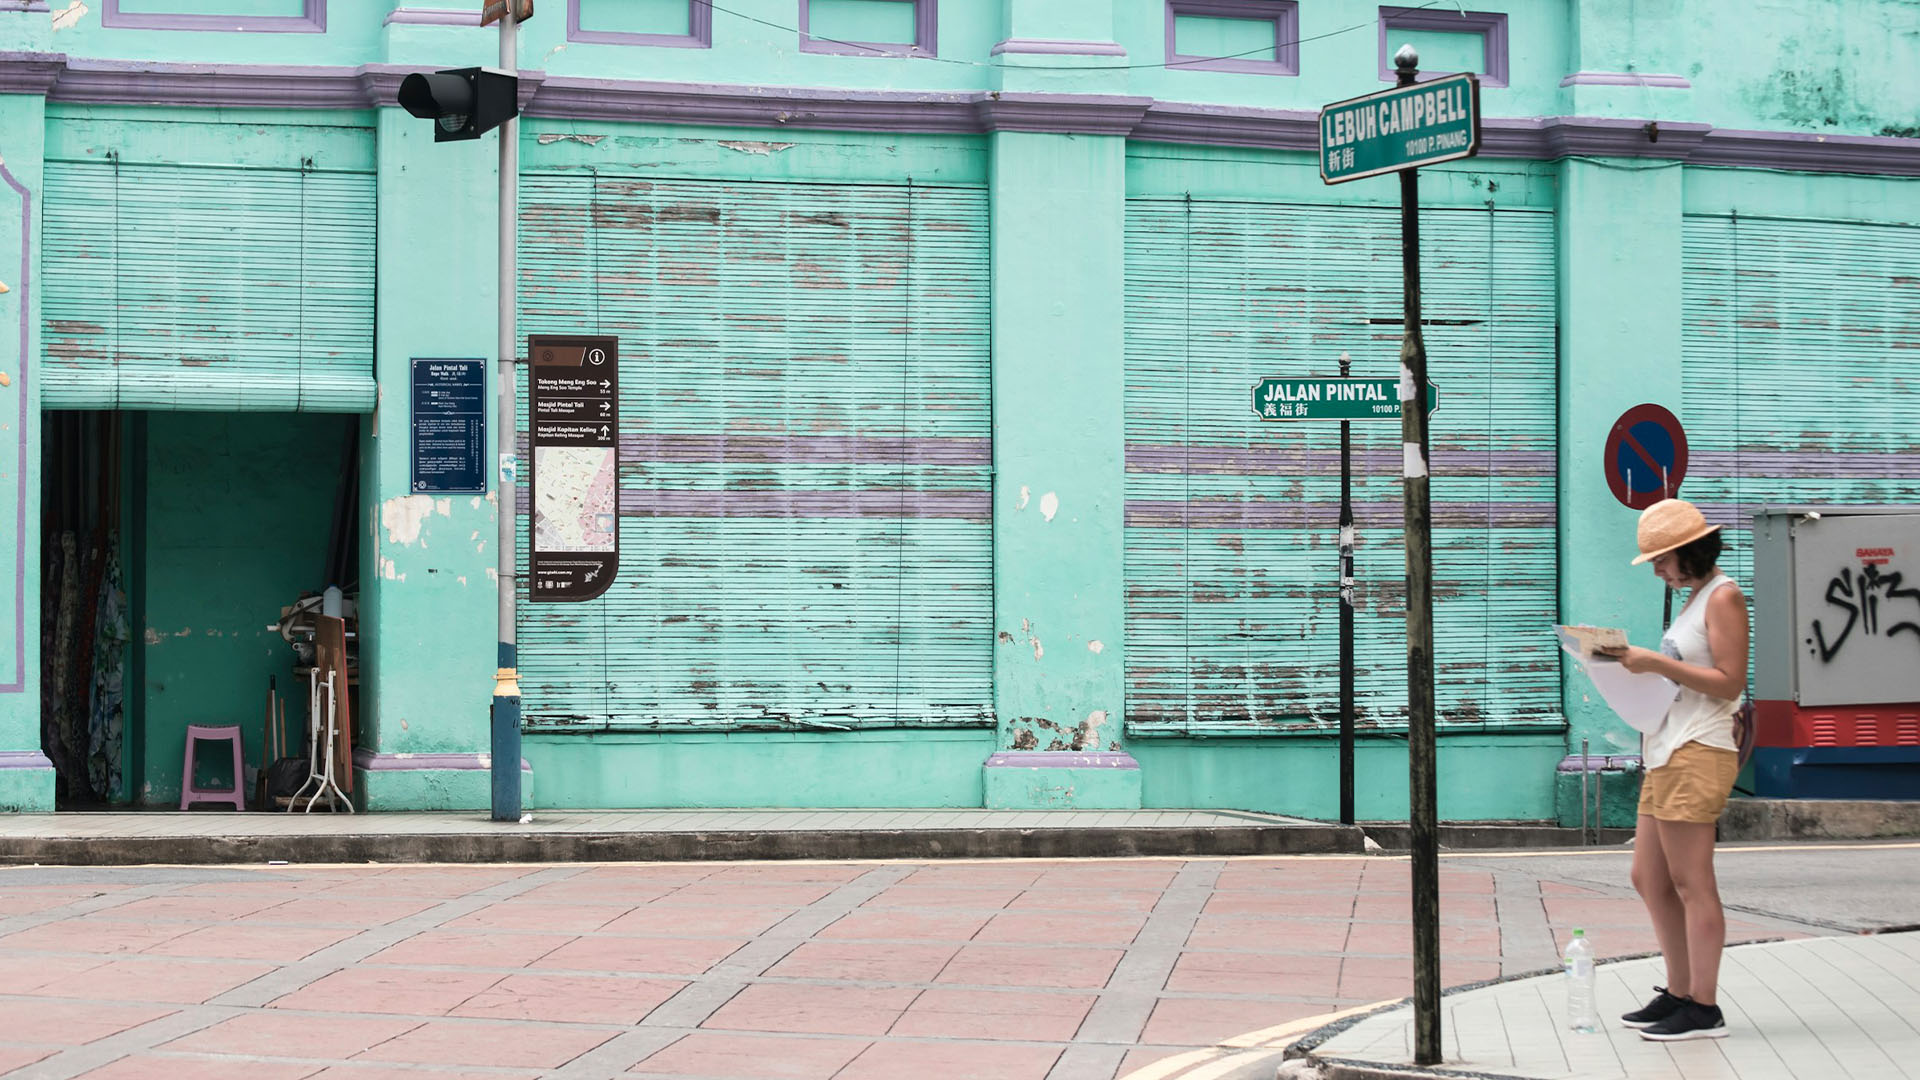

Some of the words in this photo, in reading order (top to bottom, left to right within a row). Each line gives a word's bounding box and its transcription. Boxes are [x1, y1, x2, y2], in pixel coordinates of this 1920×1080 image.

[1326, 104, 1377, 146] LEBUH
[1379, 86, 1466, 136] CAMPBELL
[1405, 137, 1427, 157] 10100
[1428, 136, 1436, 152] P.
[1436, 129, 1468, 151] PINANG
[1328, 147, 1355, 172] 新街
[1263, 384, 1320, 402] JALAN
[1326, 384, 1387, 401] PINTAL
[1263, 403, 1308, 417] 義福街
[1372, 405, 1393, 414] 10100
[1394, 405, 1401, 414] P.
